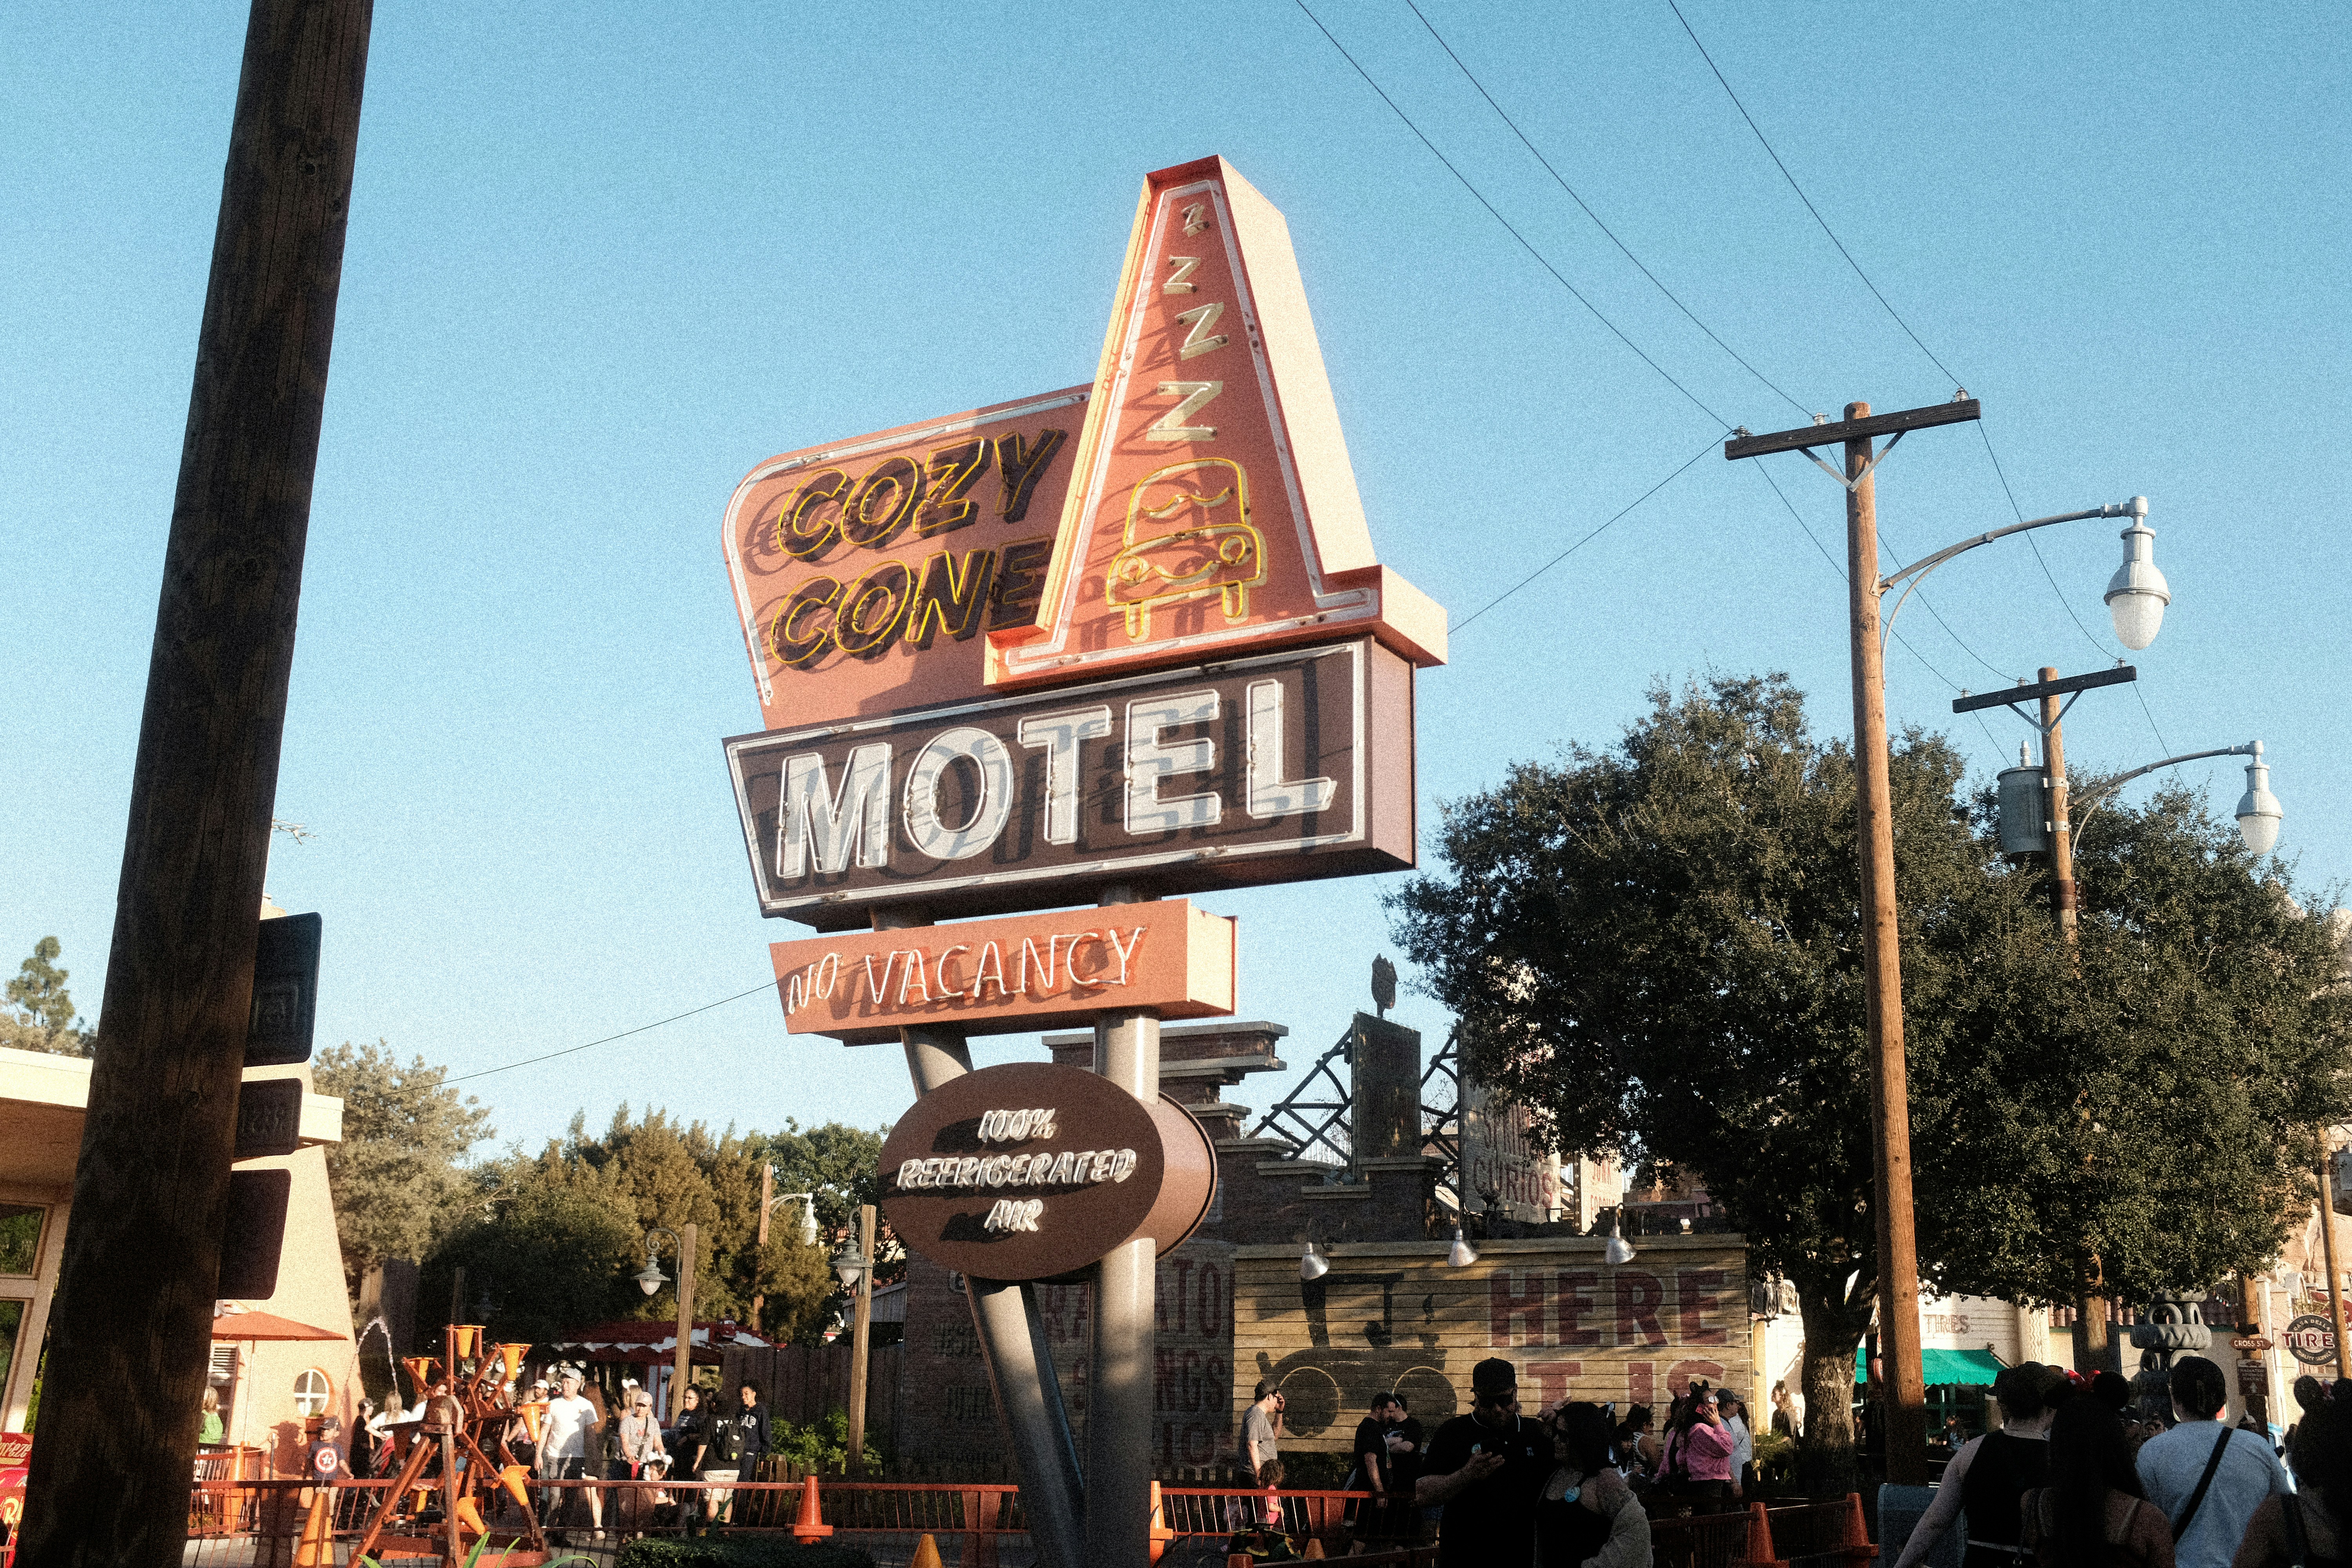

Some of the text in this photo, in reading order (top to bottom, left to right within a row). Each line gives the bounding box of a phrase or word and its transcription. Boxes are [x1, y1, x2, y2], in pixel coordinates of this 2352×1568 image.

[777, 428, 1068, 563] COZY
[770, 535, 1052, 671] CONE
[776, 679, 1337, 878] MOTEL
[788, 926, 1147, 1015] NO VACANCY
[977, 1108, 1057, 1143] 100%
[897, 1149, 1137, 1191] REFRIGERATED
[1473, 1157, 1553, 1209] CURIOS
[984, 1198, 1044, 1232] AIR
[1489, 1269, 1728, 1348] HERE
[1923, 1314, 1971, 1334] TIRES
[2281, 1332, 2335, 1348] TIRE
